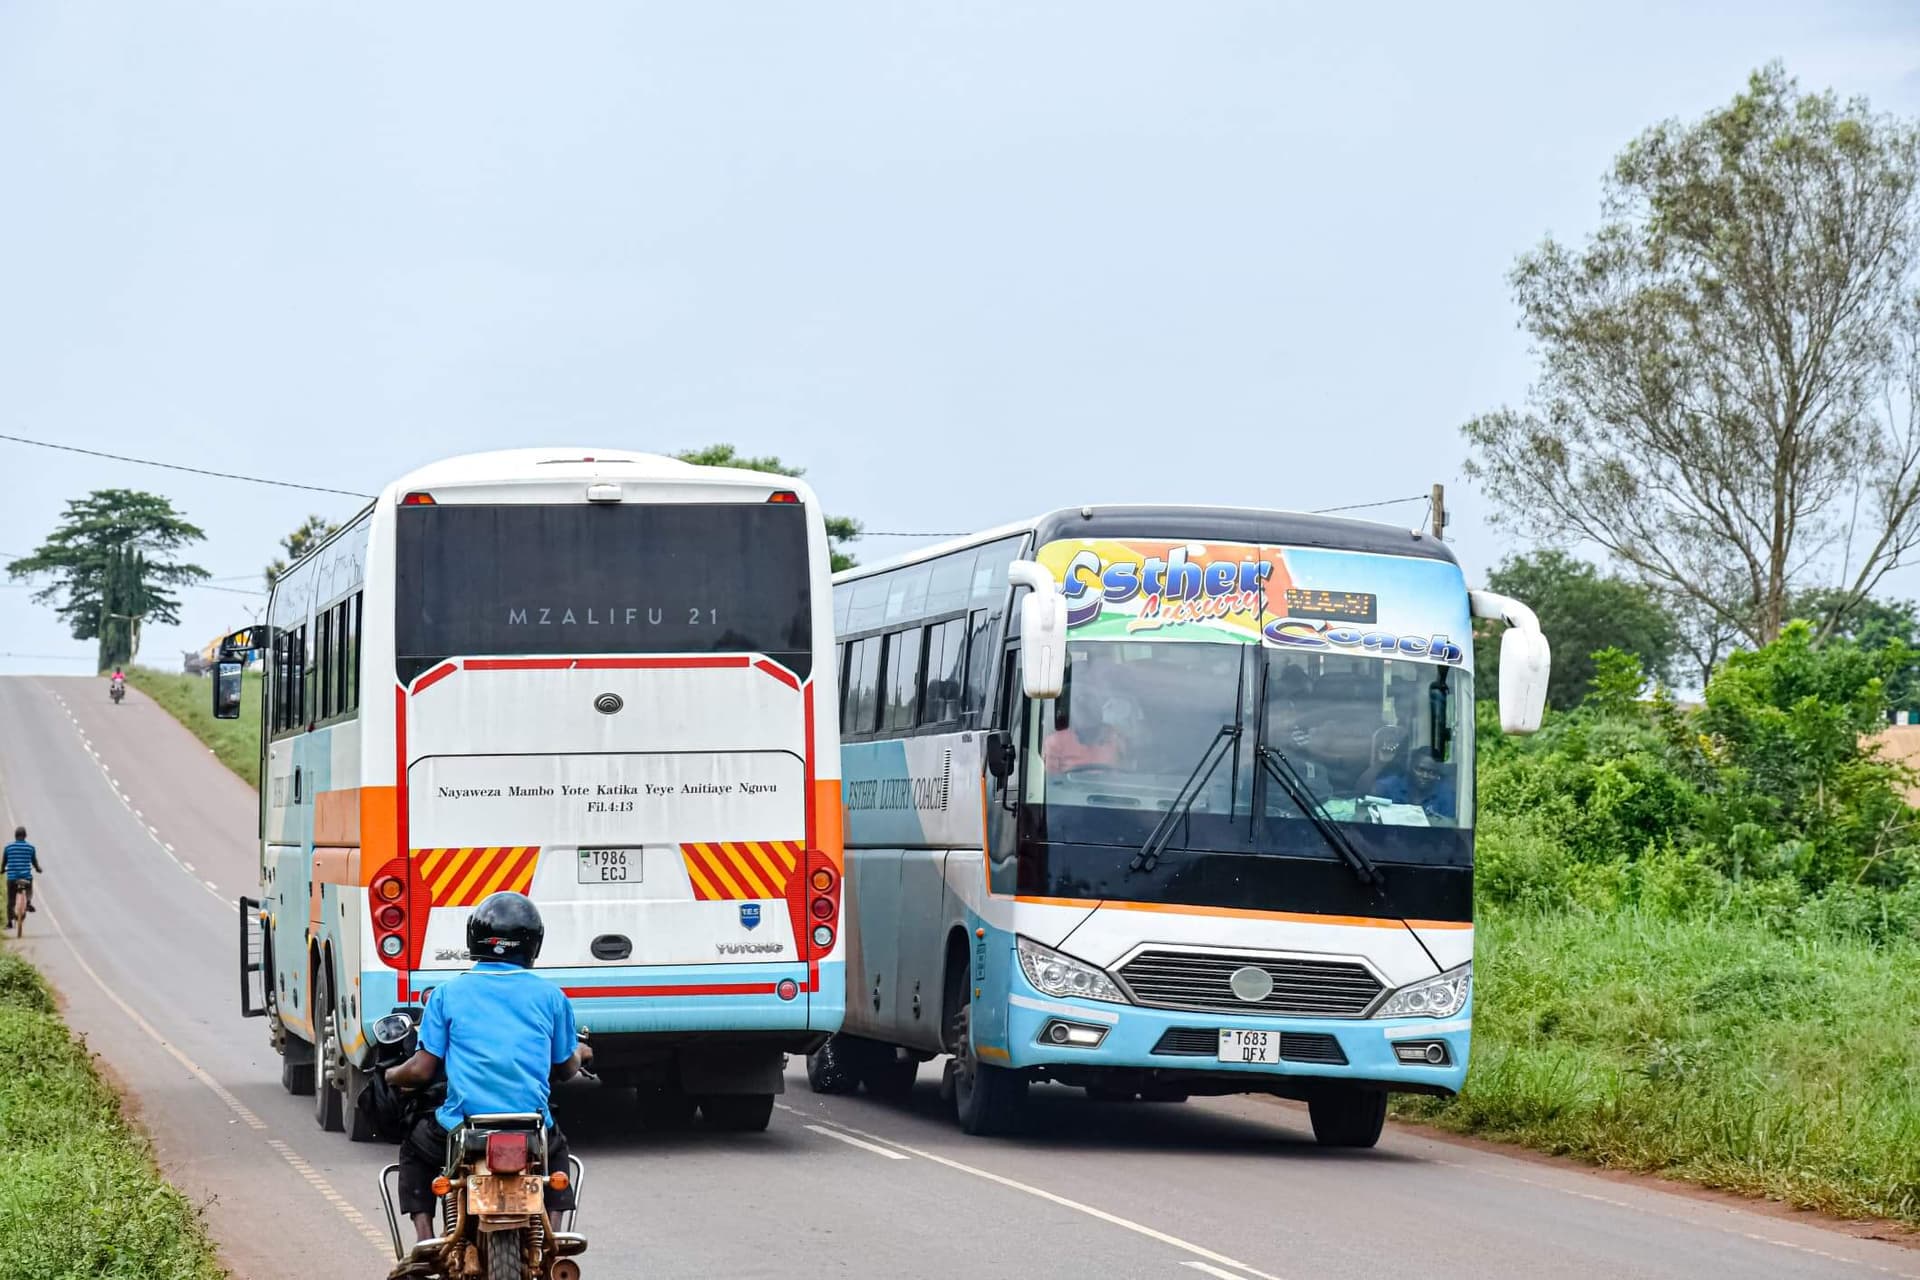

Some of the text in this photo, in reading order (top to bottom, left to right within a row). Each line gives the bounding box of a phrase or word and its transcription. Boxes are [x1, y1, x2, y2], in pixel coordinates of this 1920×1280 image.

[509, 608, 717, 624] MZALIFU 21
[1127, 592, 1266, 633] Luxury
[1263, 617, 1463, 663] Coach
[438, 782, 777, 799] Nayaweza Mambo Yote Katika Yeye Anitiaye Nguvu
[848, 777, 943, 810] ESTHER LUXURY COACH
[587, 801, 633, 812] Fil.4:13
[592, 851, 626, 865] T986
[601, 867, 627, 881] ECJ
[716, 943, 783, 955] YUTONG
[1236, 1031, 1267, 1045] T683
[1242, 1047, 1266, 1061] DFX
